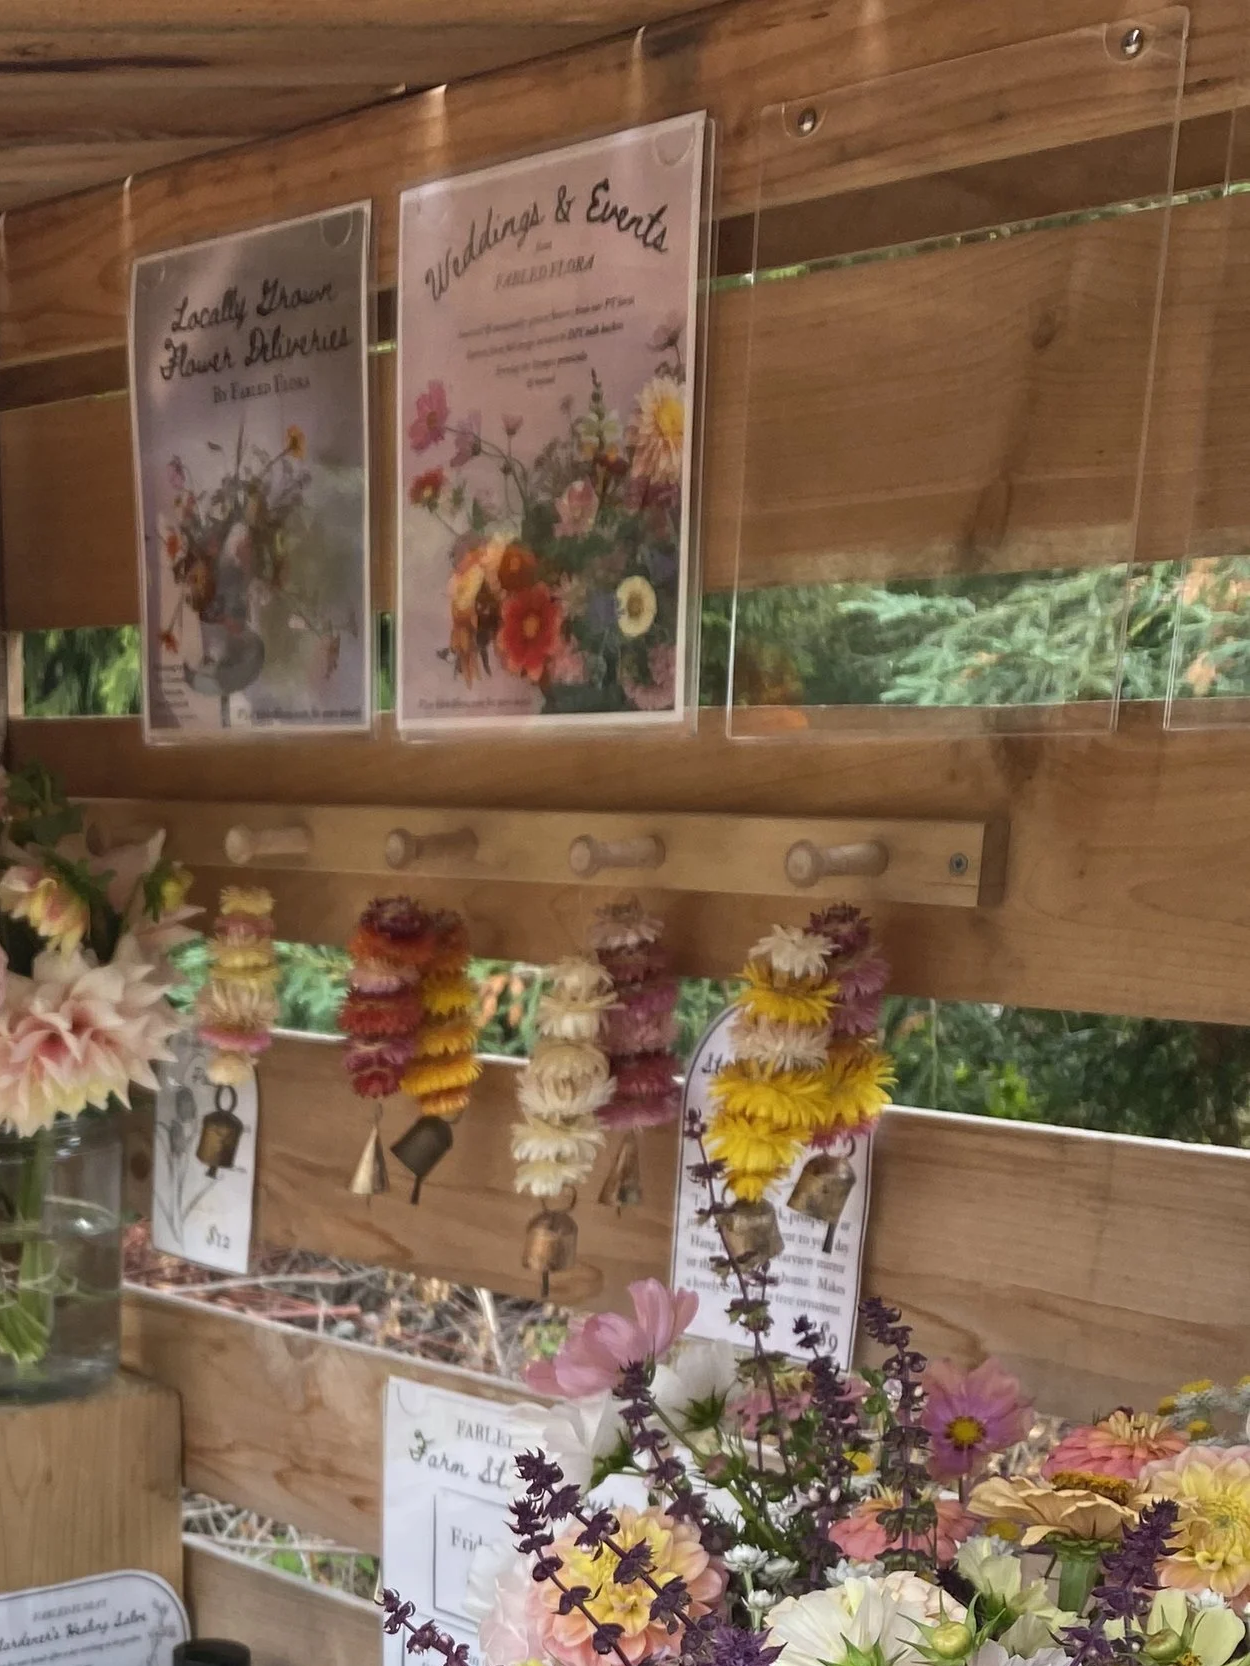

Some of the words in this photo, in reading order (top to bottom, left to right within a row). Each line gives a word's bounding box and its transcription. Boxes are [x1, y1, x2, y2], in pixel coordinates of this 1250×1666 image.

[425, 202, 547, 301] Weddings
[555, 184, 577, 223] &
[586, 177, 669, 253] Events
[494, 264, 548, 290] FABLED
[549, 254, 597, 278] FLORA
[171, 286, 248, 332] Locally
[256, 278, 338, 317] Grown
[160, 337, 235, 381] Flower
[245, 325, 354, 367] Deliveries
[409, 1428, 471, 1479] Farm
[66, 1618, 109, 1639] Healing
[113, 1608, 147, 1629] Salve
